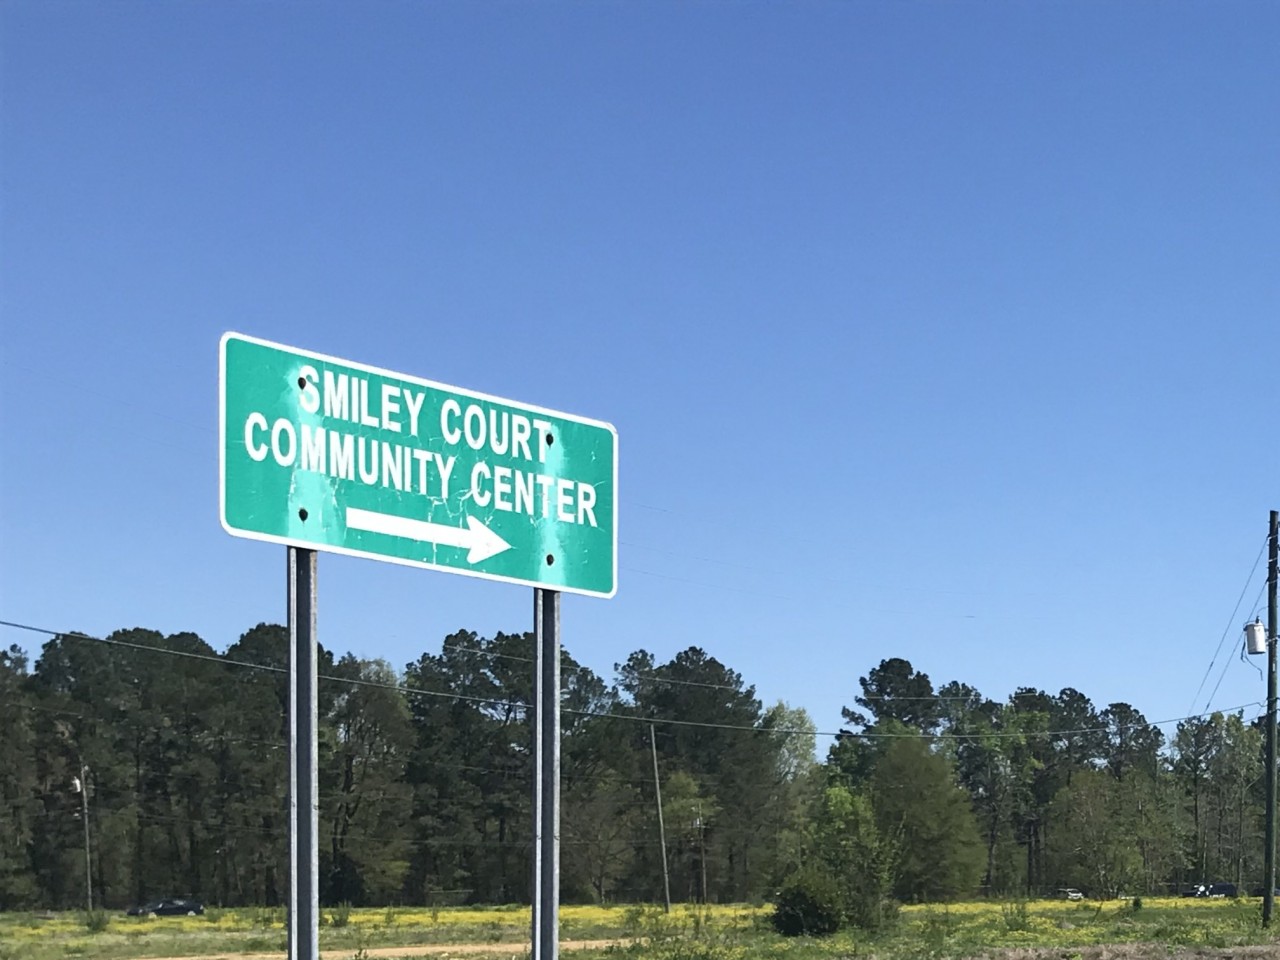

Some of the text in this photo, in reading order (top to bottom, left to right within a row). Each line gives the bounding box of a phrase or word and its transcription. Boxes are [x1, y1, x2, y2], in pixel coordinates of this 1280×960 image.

[298, 365, 552, 464] SMILEY COURT
[244, 411, 598, 528] COMMUNITY CENTER
